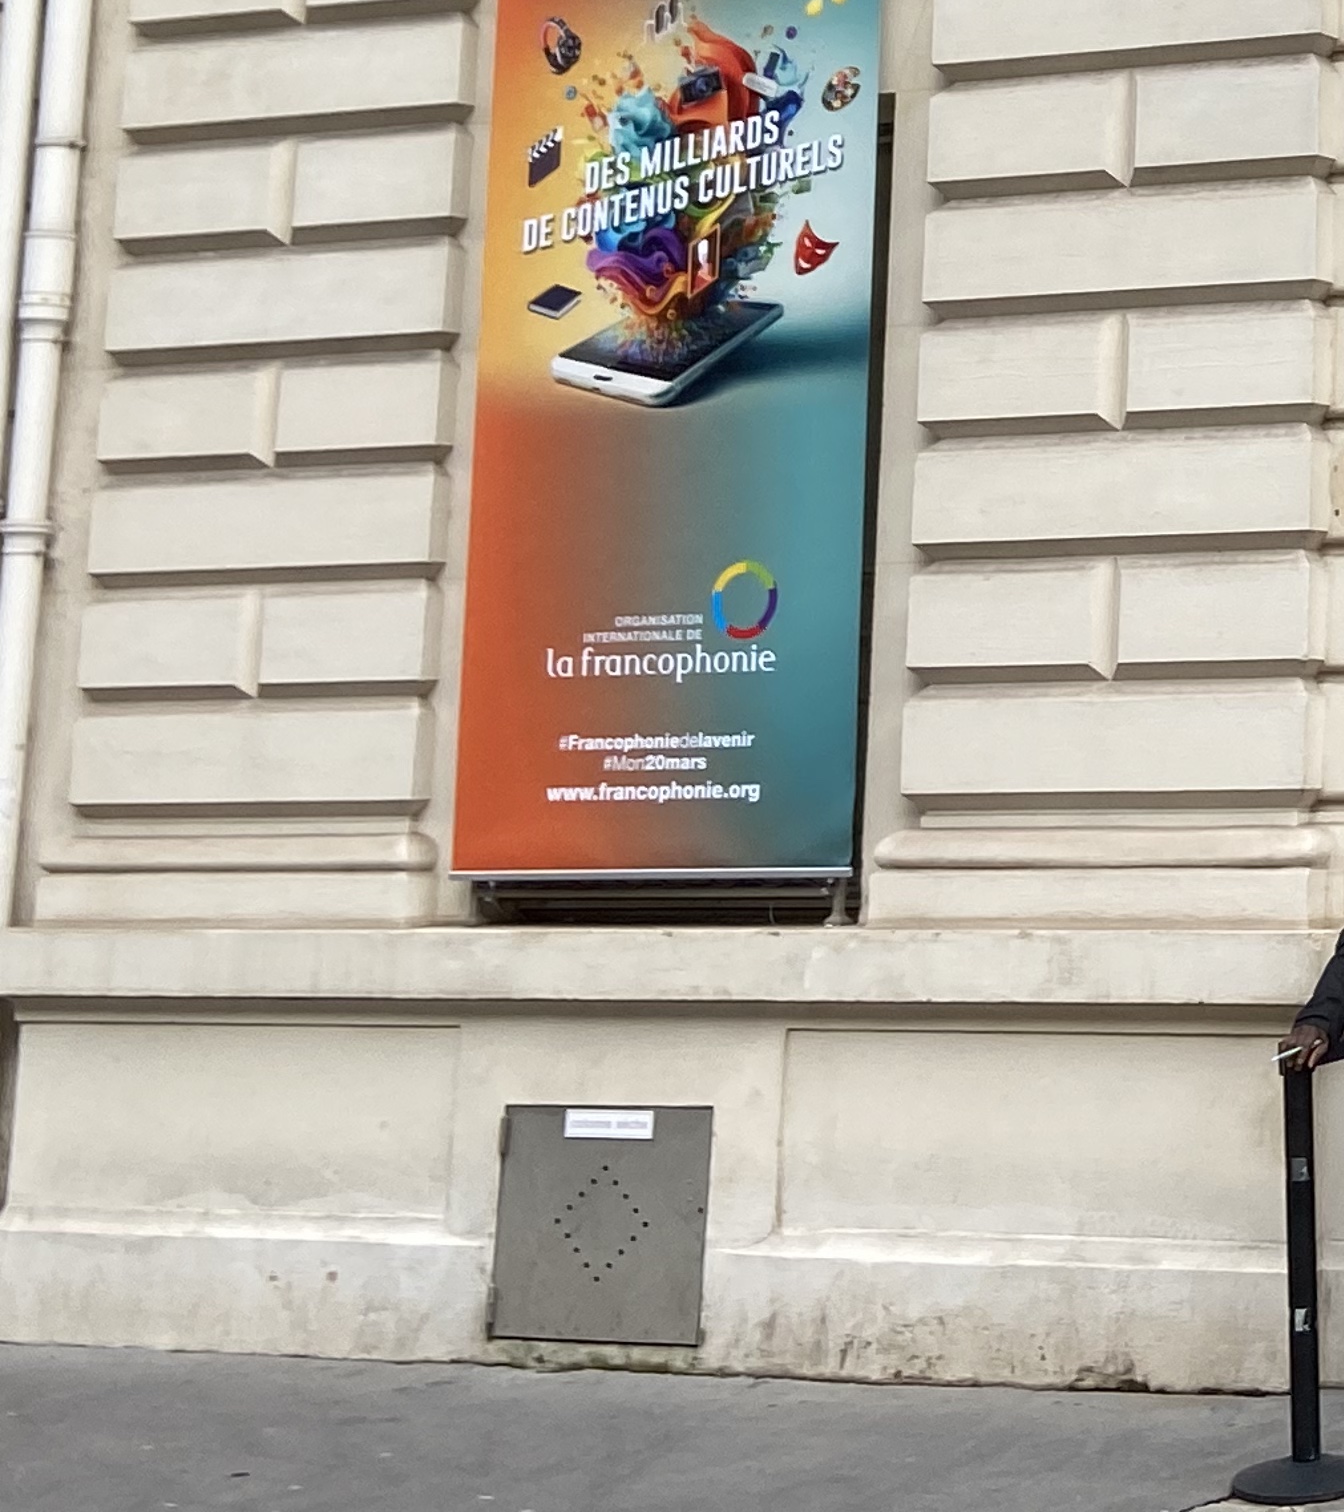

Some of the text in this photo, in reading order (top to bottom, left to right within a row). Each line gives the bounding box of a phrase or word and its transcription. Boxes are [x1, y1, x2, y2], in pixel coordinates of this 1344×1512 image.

[585, 109, 780, 194] DES MILLIARDS
[522, 134, 844, 254] DE CONTENUS CULTURELS
[615, 614, 703, 628] ORGANISATION
[583, 629, 702, 643] INTERNATIONALE DE
[546, 643, 776, 683] la francophonie
[559, 730, 755, 752] #Francophoniedelavenir
[603, 755, 707, 771] #Mon20mars
[546, 781, 760, 803] www.francophonie.org
